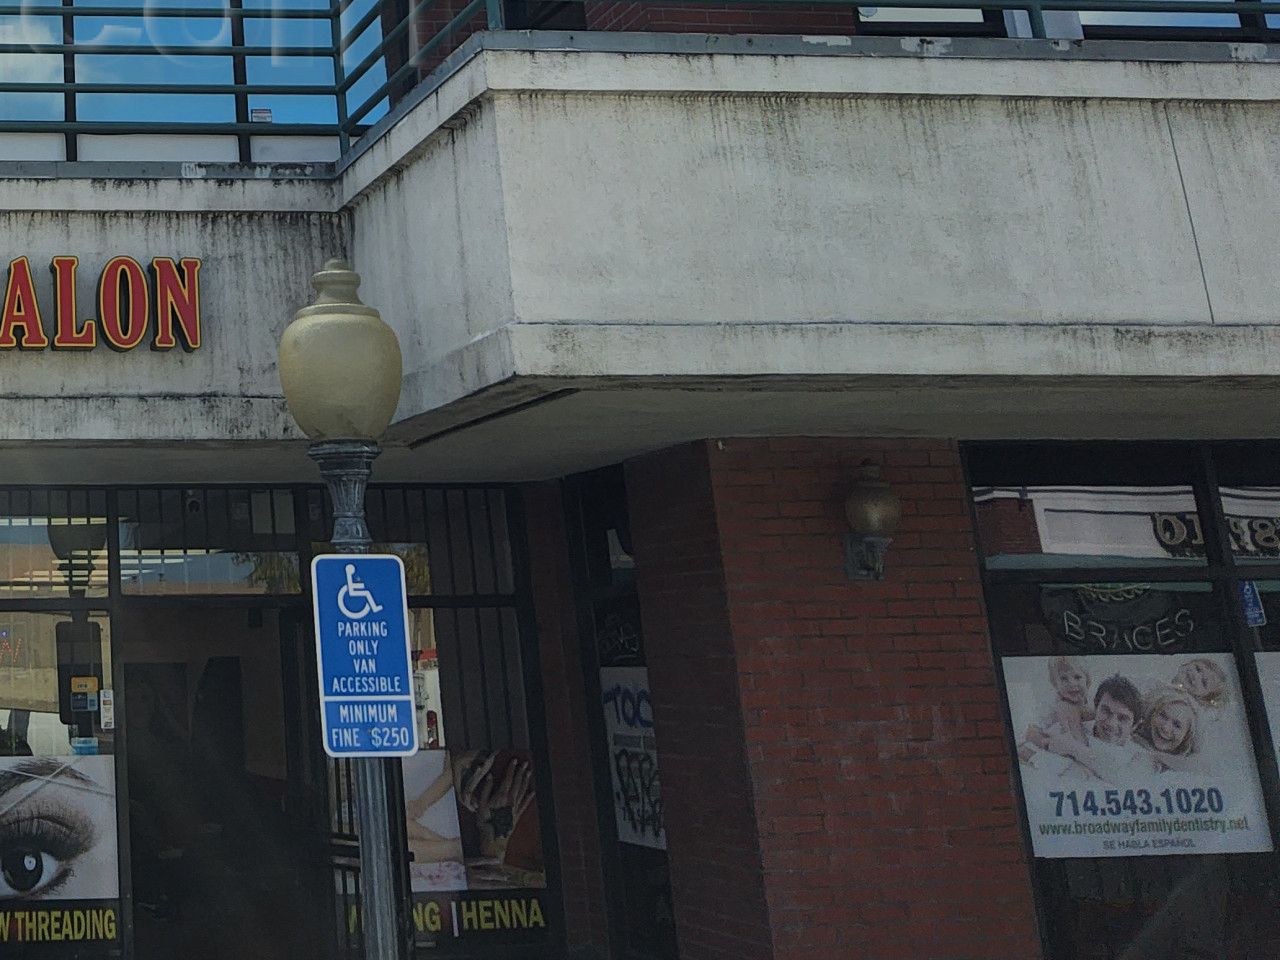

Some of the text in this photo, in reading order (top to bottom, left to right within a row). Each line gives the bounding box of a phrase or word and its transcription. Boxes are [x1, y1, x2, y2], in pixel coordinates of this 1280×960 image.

[338, 621, 388, 637] PARKING
[349, 639, 379, 656] ONLY
[353, 658, 377, 674] VAN
[332, 676, 402, 693] ACCESSIBLE
[339, 704, 398, 723] MINIMUM
[331, 726, 410, 748] FINE $250
[1049, 787, 1224, 817] 714.543.1020
[460, 897, 546, 931] HENNA
[14, 908, 117, 943] THREADING
